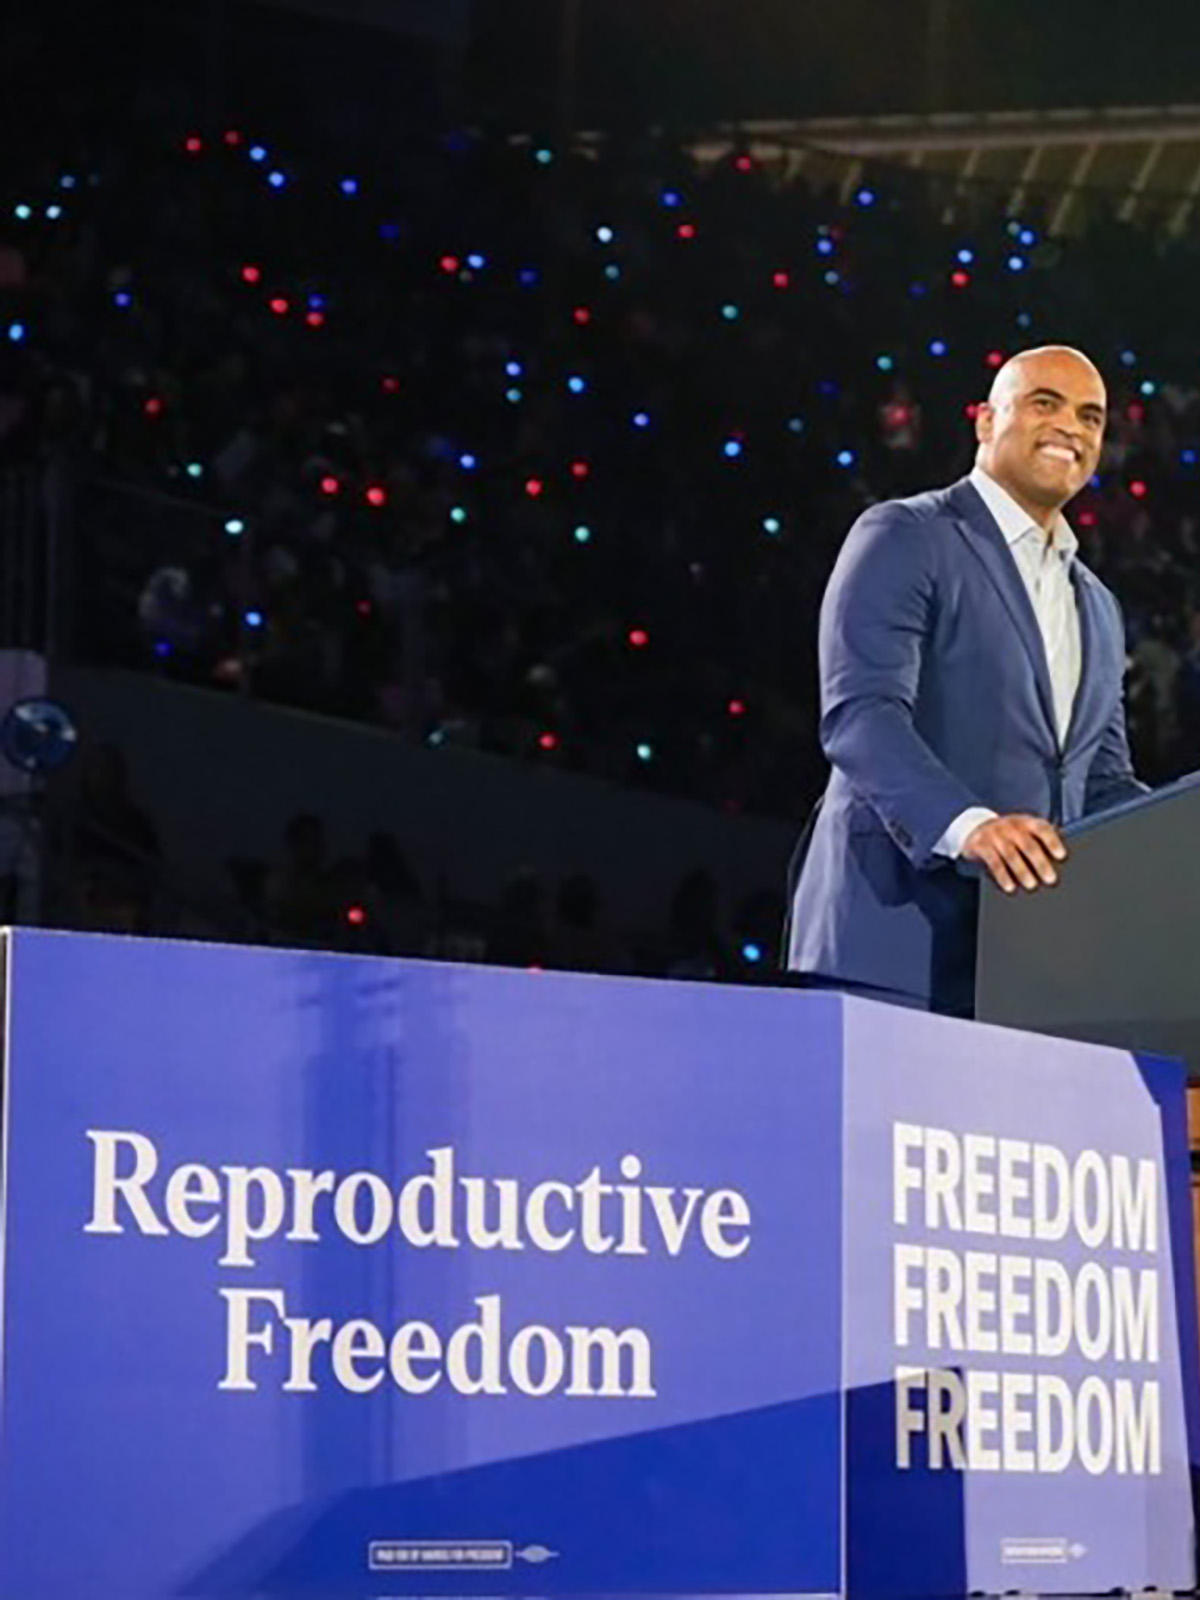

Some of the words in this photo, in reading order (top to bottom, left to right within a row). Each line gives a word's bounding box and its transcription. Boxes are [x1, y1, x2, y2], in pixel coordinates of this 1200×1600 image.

[83, 1129, 751, 1267] Reproductive
[892, 1121, 1157, 1251] FREEDOM
[217, 1287, 658, 1398] Freedom
[893, 1243, 1160, 1362] FREEDOM
[896, 1365, 1162, 1475] FREEDOM
